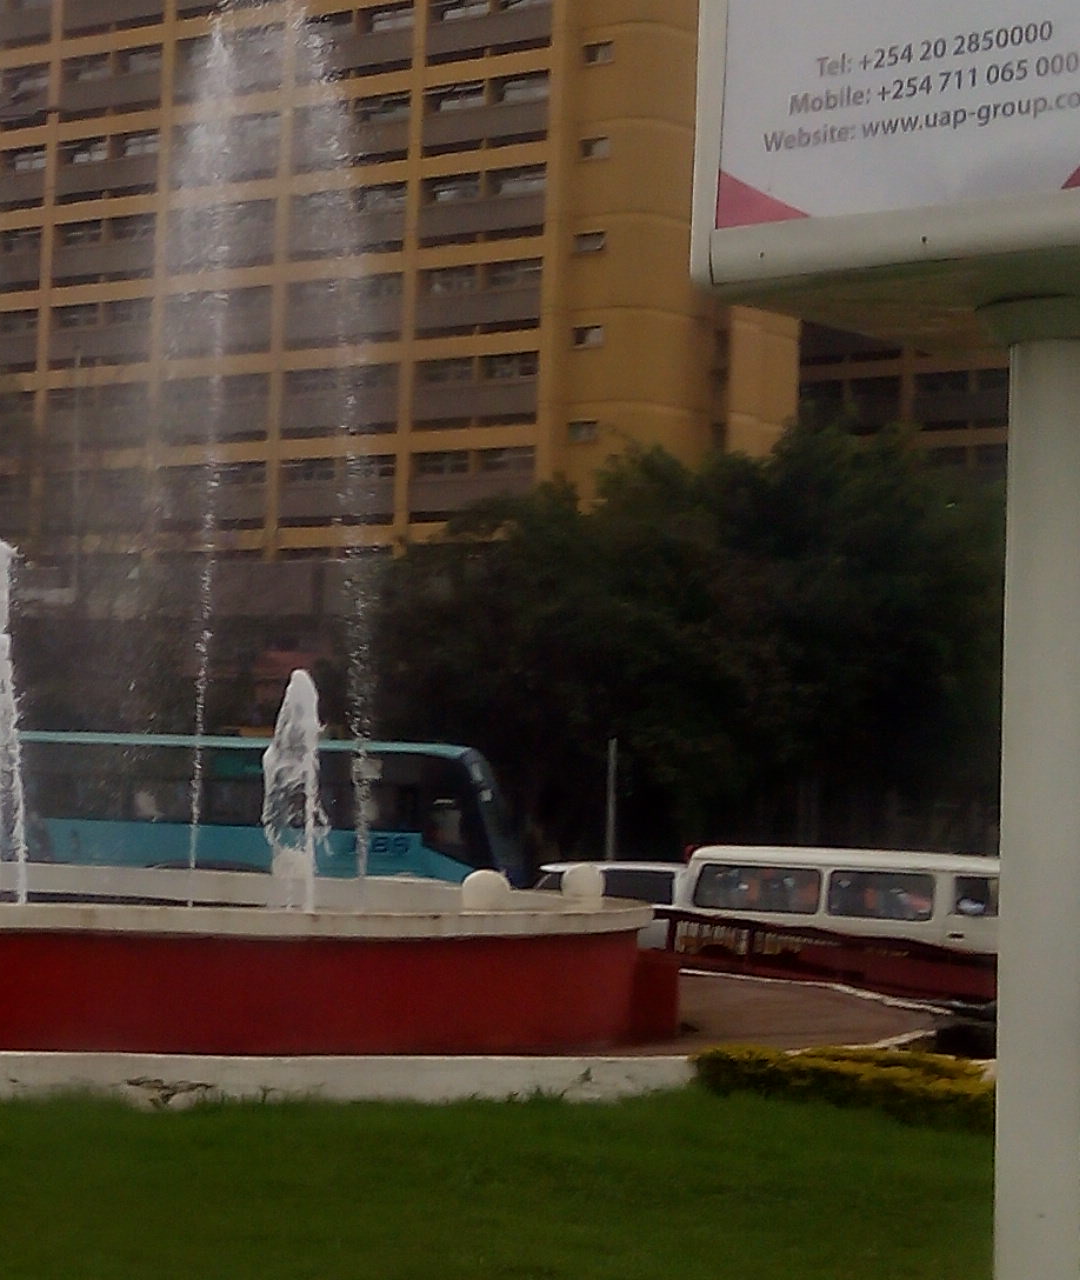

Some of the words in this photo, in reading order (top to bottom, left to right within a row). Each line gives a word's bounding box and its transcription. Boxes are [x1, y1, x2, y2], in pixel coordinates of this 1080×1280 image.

[817, 52, 853, 78] Tel:
[859, 43, 913, 70] +254
[919, 38, 948, 62] 20
[953, 20, 1054, 56] 2850000
[789, 86, 871, 116] Mobile:
[877, 75, 933, 102] +254
[938, 67, 977, 93] 711
[985, 58, 1029, 86] 065
[1035, 51, 1080, 78] 000
[763, 122, 857, 153] Website:
